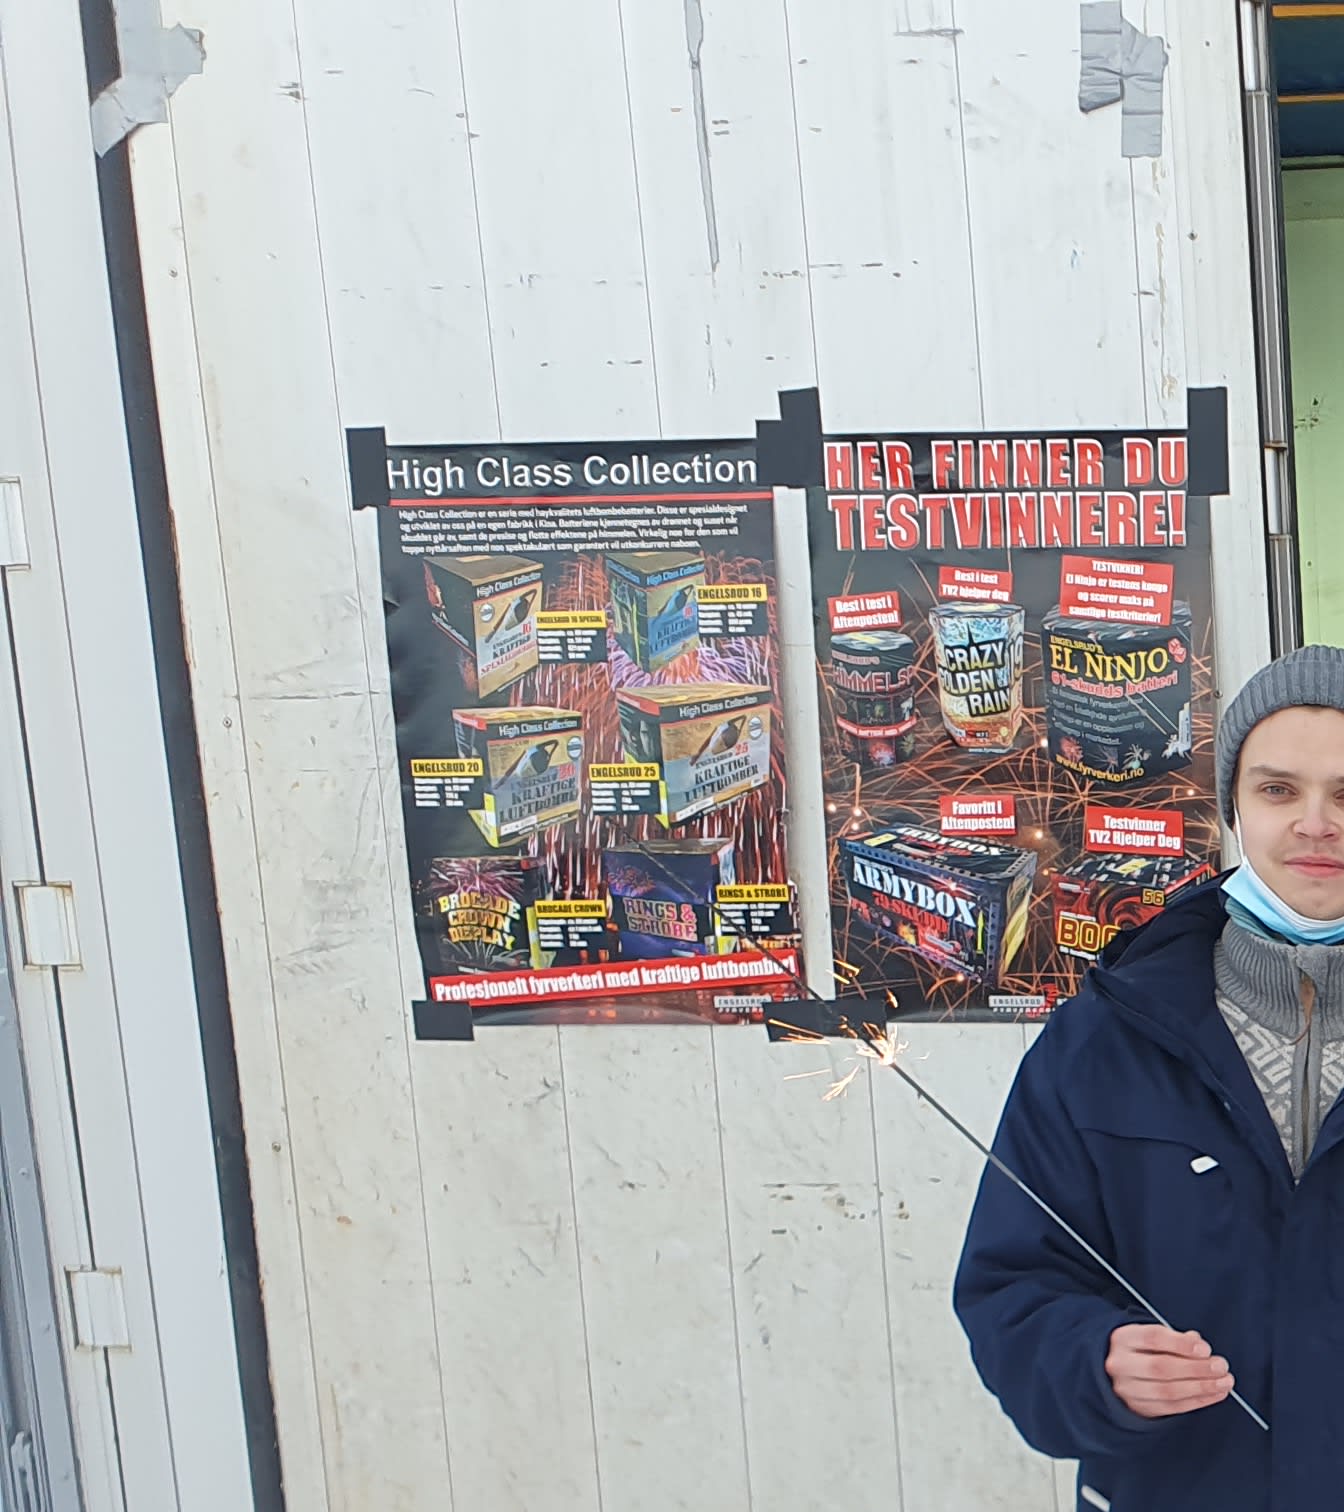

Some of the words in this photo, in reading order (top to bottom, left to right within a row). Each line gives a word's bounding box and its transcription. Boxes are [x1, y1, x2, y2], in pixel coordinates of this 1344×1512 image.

[387, 457, 465, 497] High
[477, 456, 573, 490] Class
[583, 452, 758, 486] Collection
[823, 441, 915, 491] HER
[931, 438, 1105, 490] FINNER
[1123, 436, 1189, 488] DU
[828, 490, 1187, 551] TESTVINNERE!
[698, 587, 750, 599] ENGELSRUD
[945, 640, 1005, 671] CRAZY
[1049, 644, 1078, 674] EL
[1085, 647, 1169, 683] NINJO
[969, 690, 1010, 716] RAIN
[414, 763, 465, 773] ENGELSRUD
[467, 762, 480, 773] 20
[591, 766, 642, 778] ENGELSRUD
[644, 765, 657, 777] 25
[1103, 815, 1167, 833] Testvinner
[1089, 830, 1111, 844] TV2
[1158, 834, 1181, 850] Deg
[853, 860, 977, 928] ARMYBOX
[1142, 888, 1166, 905] 56
[623, 897, 678, 920] RINGS
[435, 976, 528, 1001] Profesjonelt
[528, 970, 603, 994] fyrverkeri
[606, 967, 640, 986] med
[641, 962, 700, 985] kraftige
